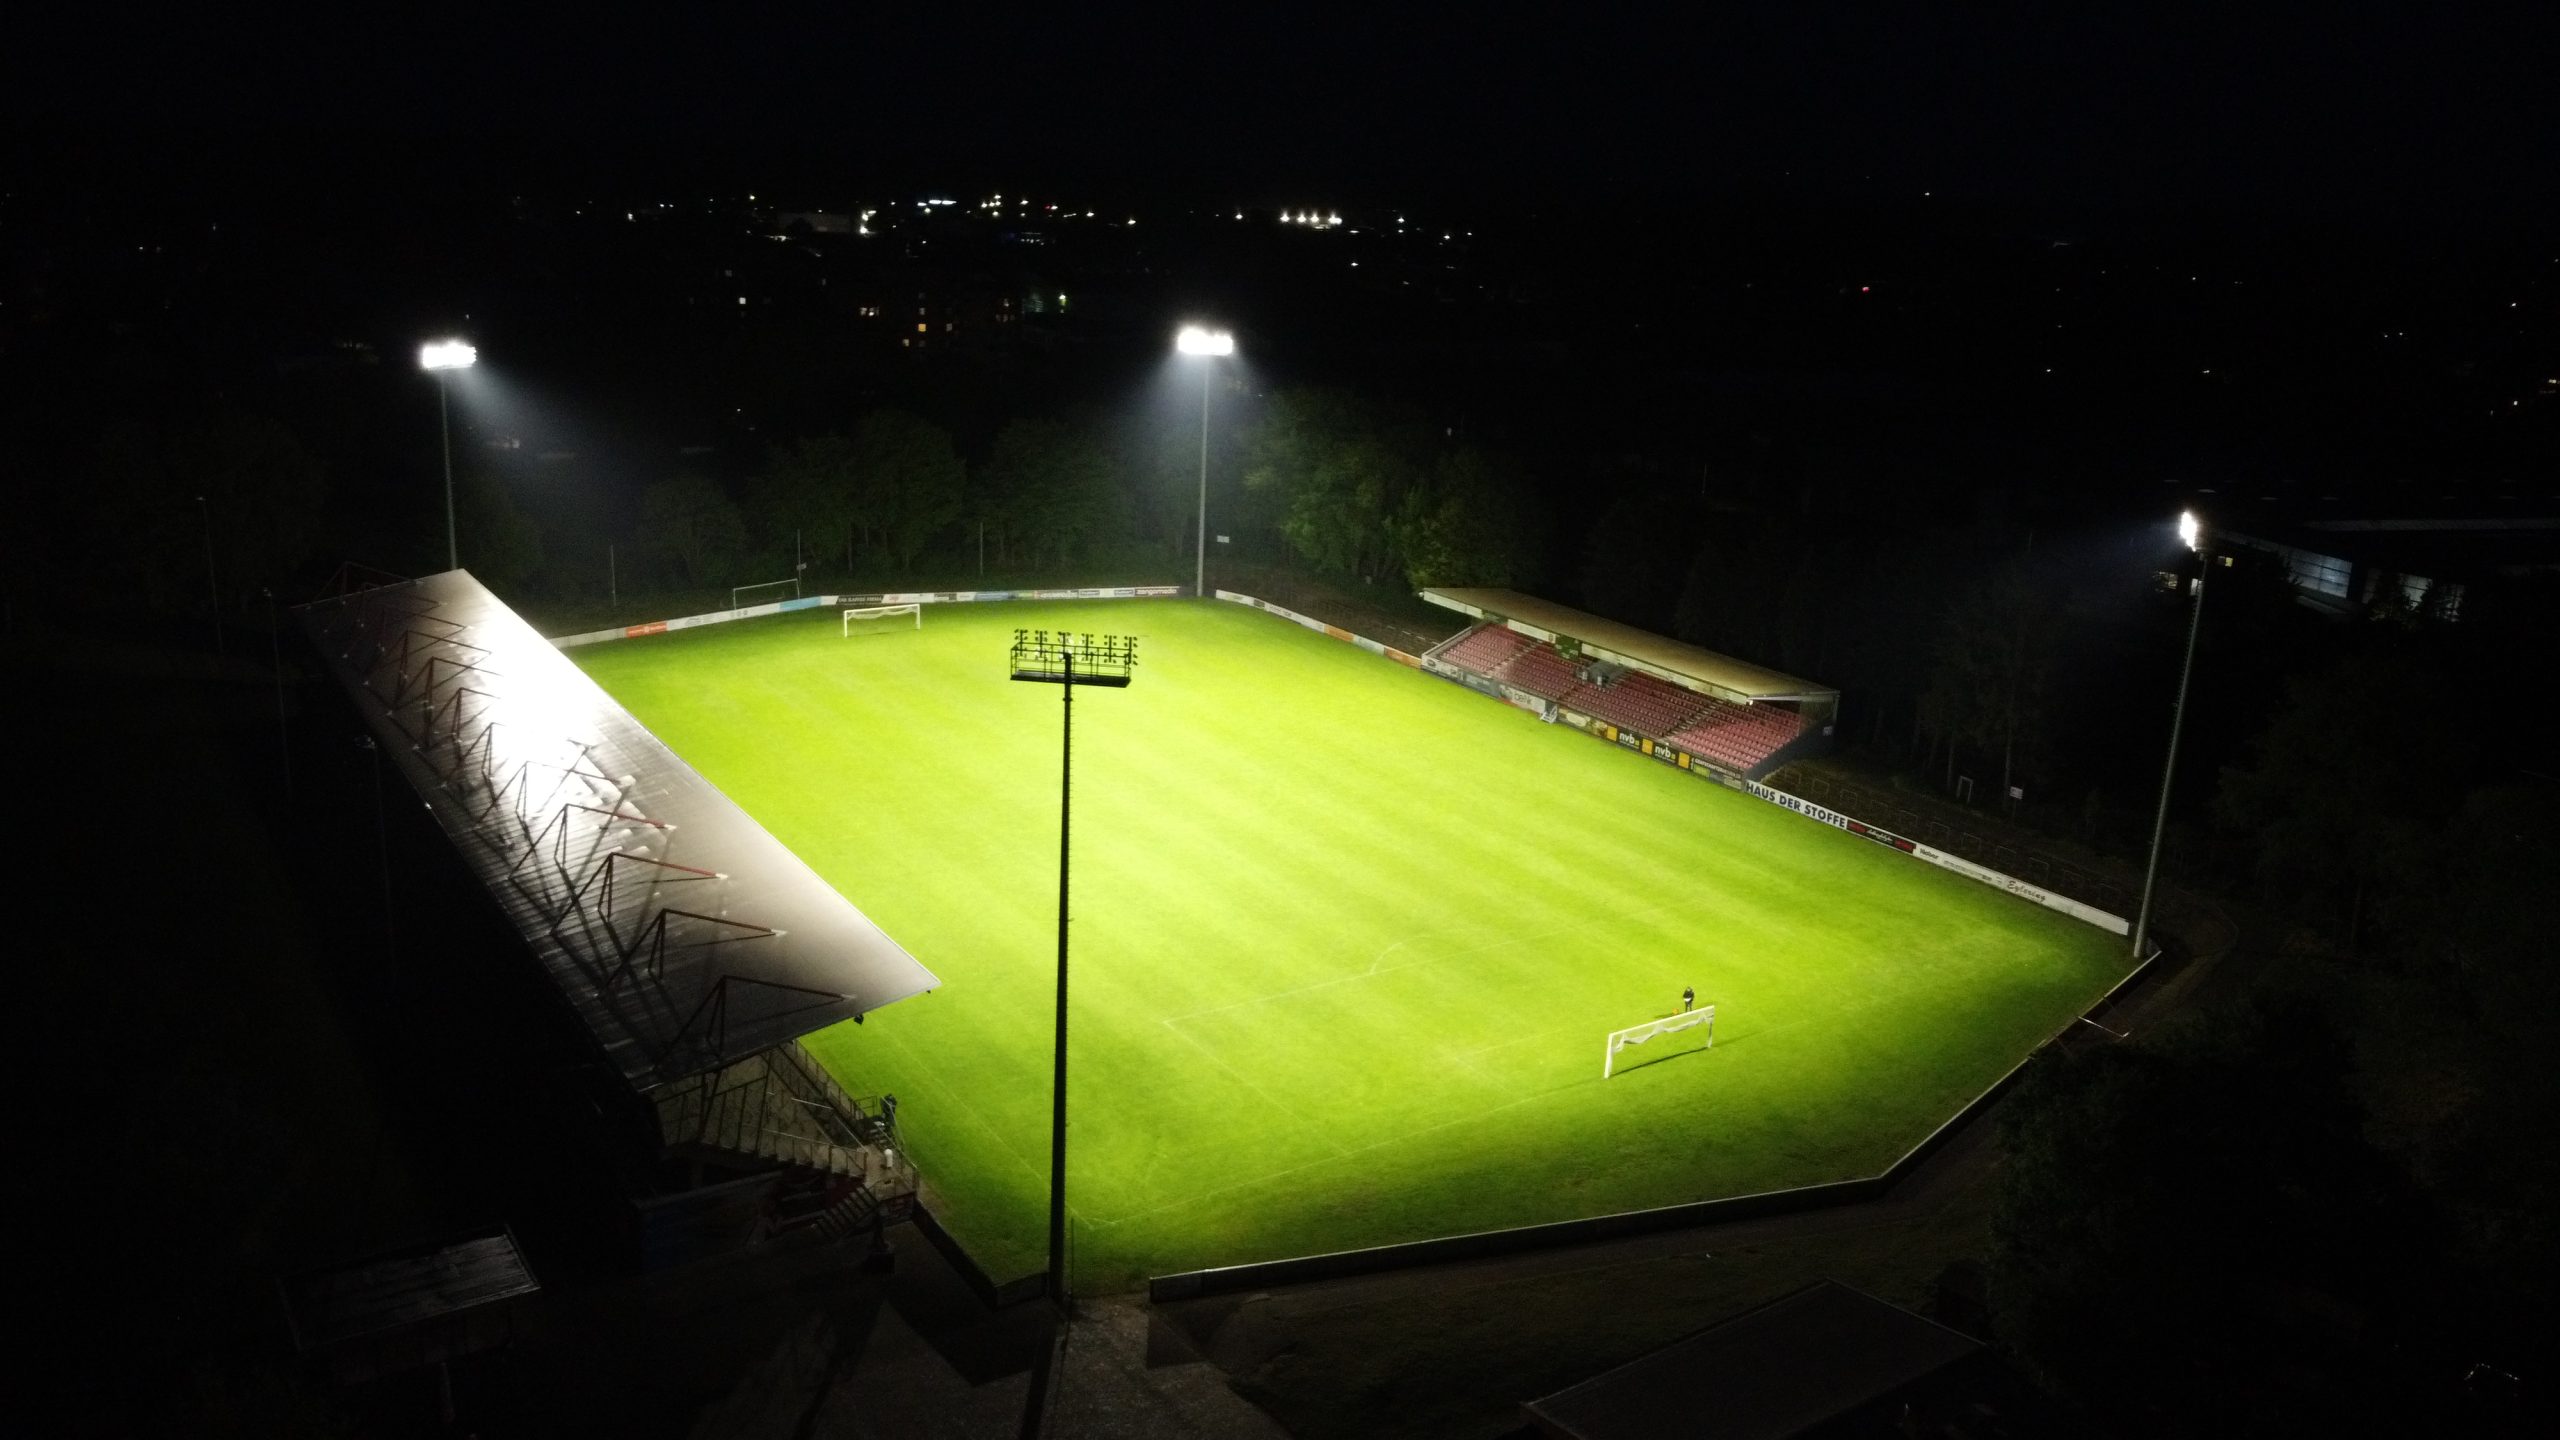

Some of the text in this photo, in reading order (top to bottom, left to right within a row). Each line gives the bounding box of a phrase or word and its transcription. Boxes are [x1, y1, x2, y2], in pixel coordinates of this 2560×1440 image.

[1619, 733, 1635, 744] nvb
[1655, 746, 1671, 758] nvb
[1746, 782, 1775, 801] HAUS
[1779, 795, 1801, 811] DER
[1804, 804, 1845, 828] STOFFE
